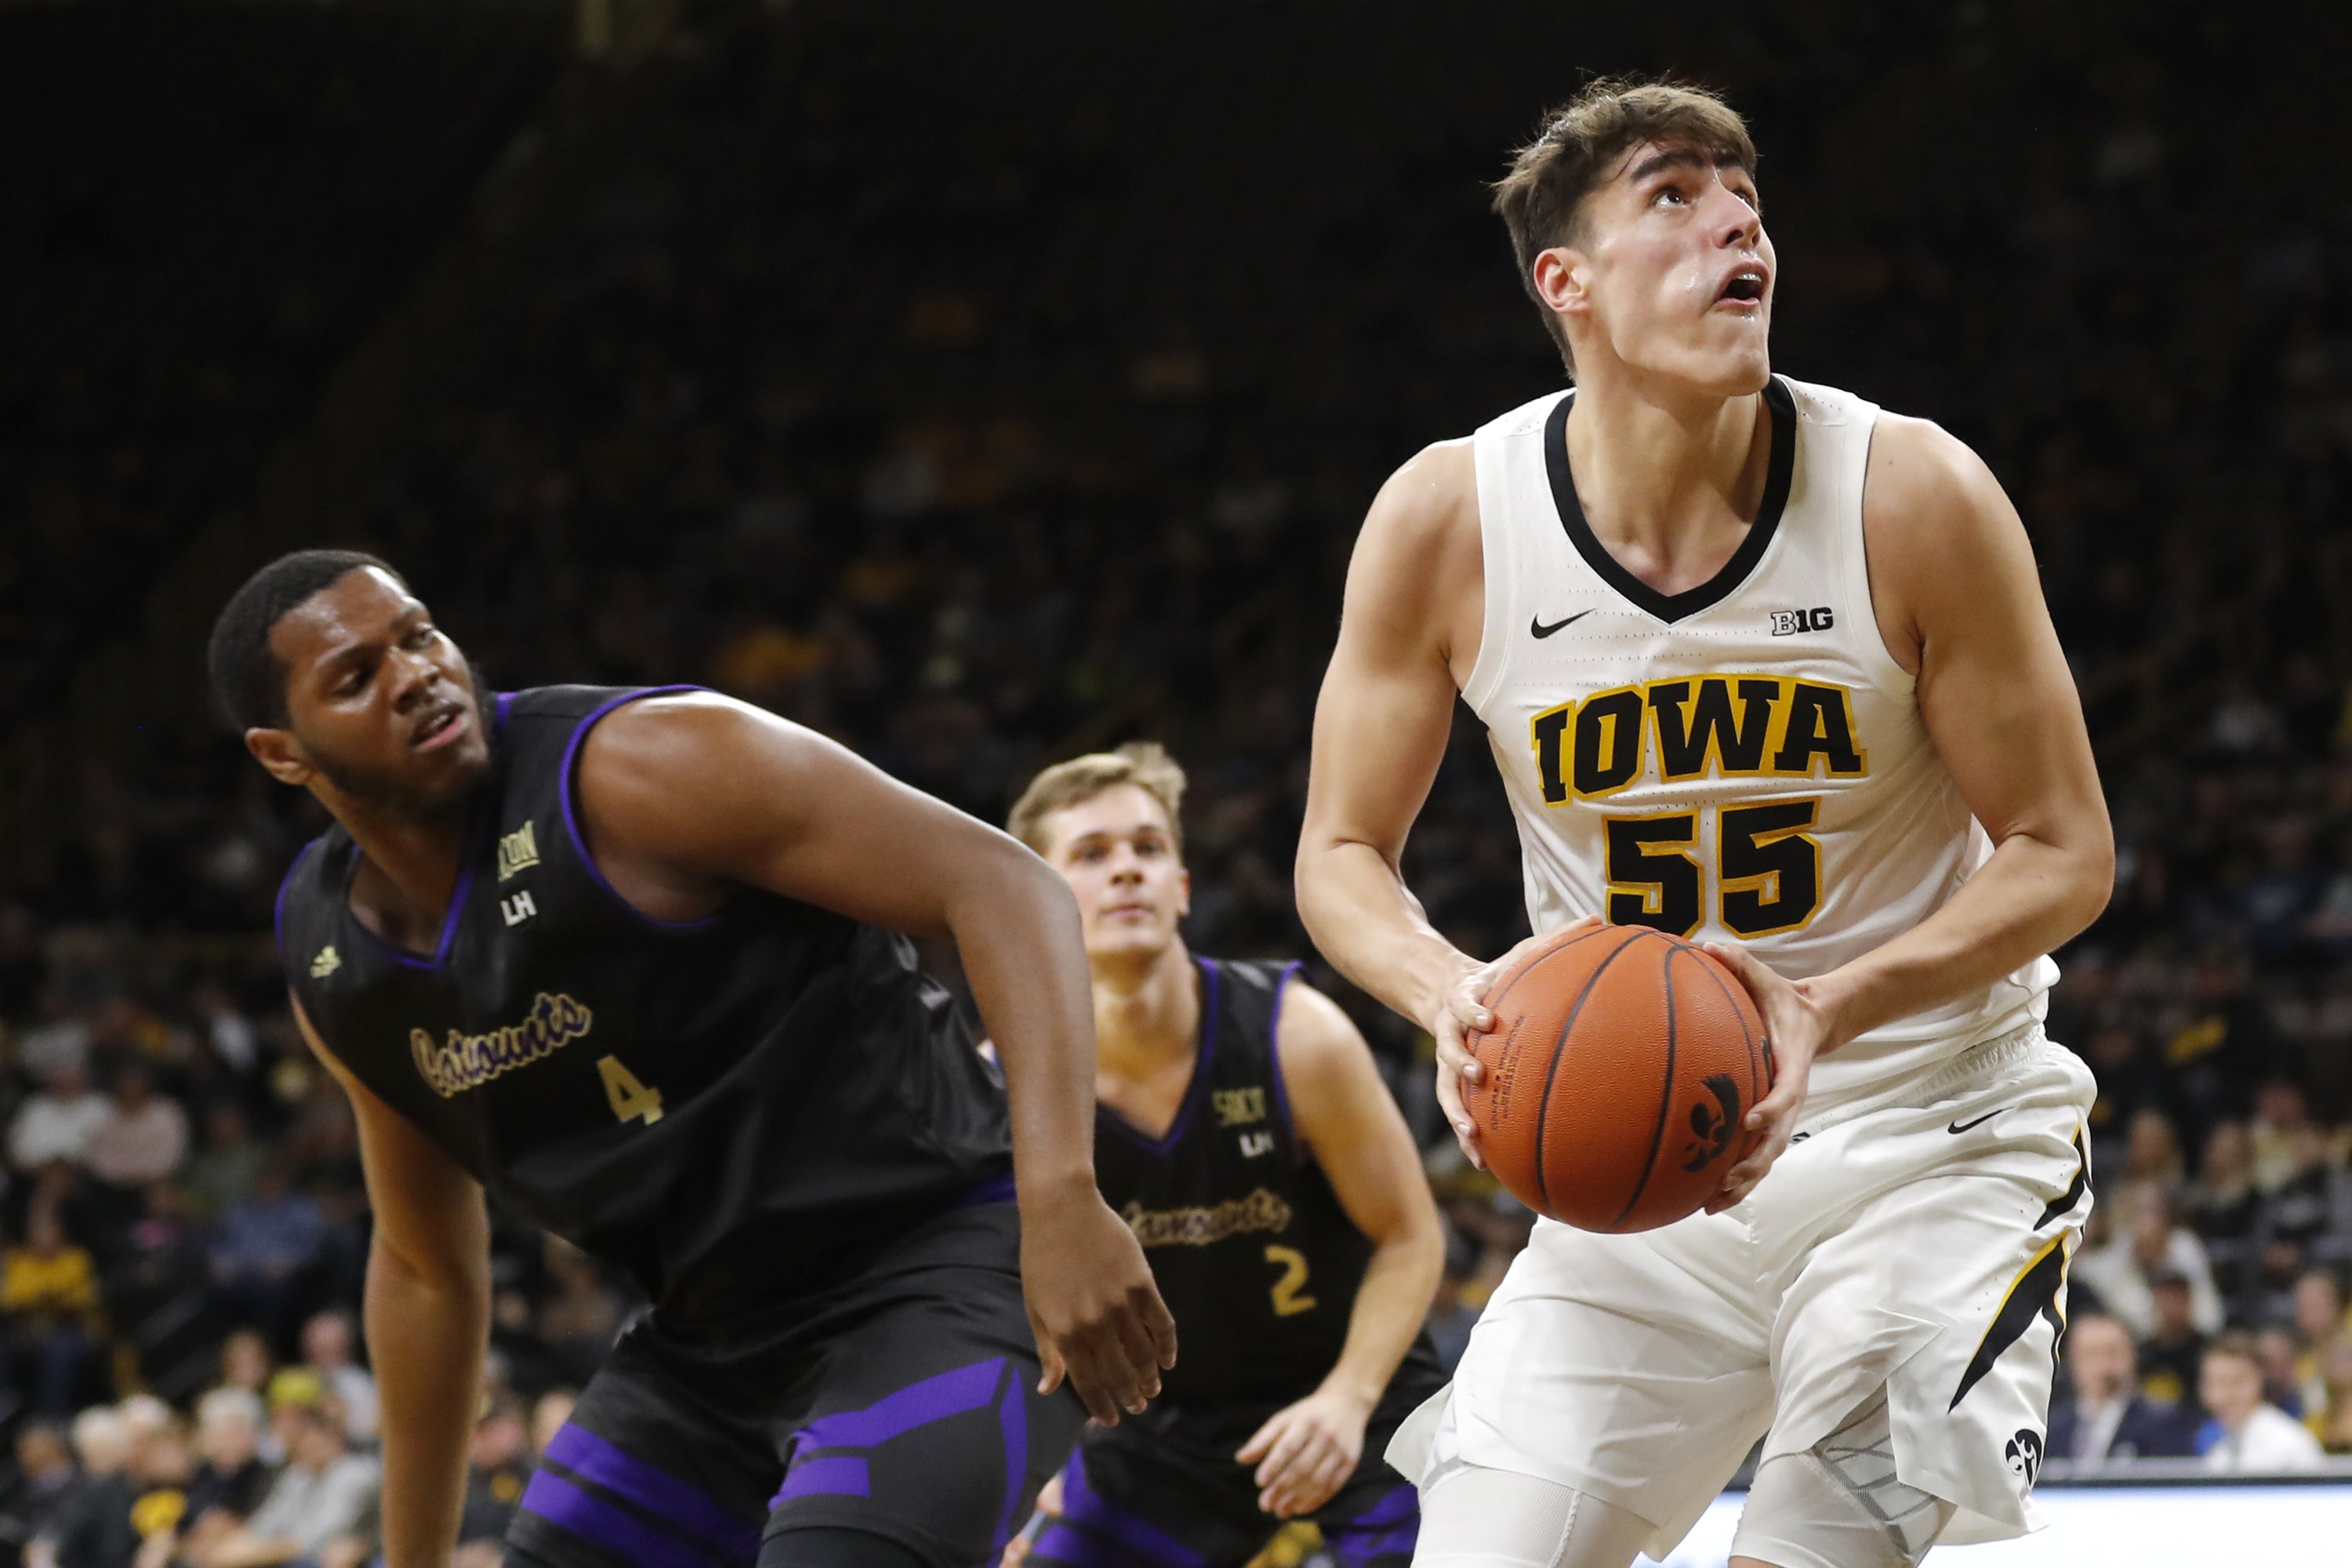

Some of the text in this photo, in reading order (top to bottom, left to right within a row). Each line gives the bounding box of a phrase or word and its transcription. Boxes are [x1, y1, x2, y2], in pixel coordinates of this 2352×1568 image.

[1530, 673, 1867, 808] IOWA
[1602, 796, 1824, 940] 55
[597, 1054, 665, 1126] 4
[1264, 1243, 1318, 1318] 2
